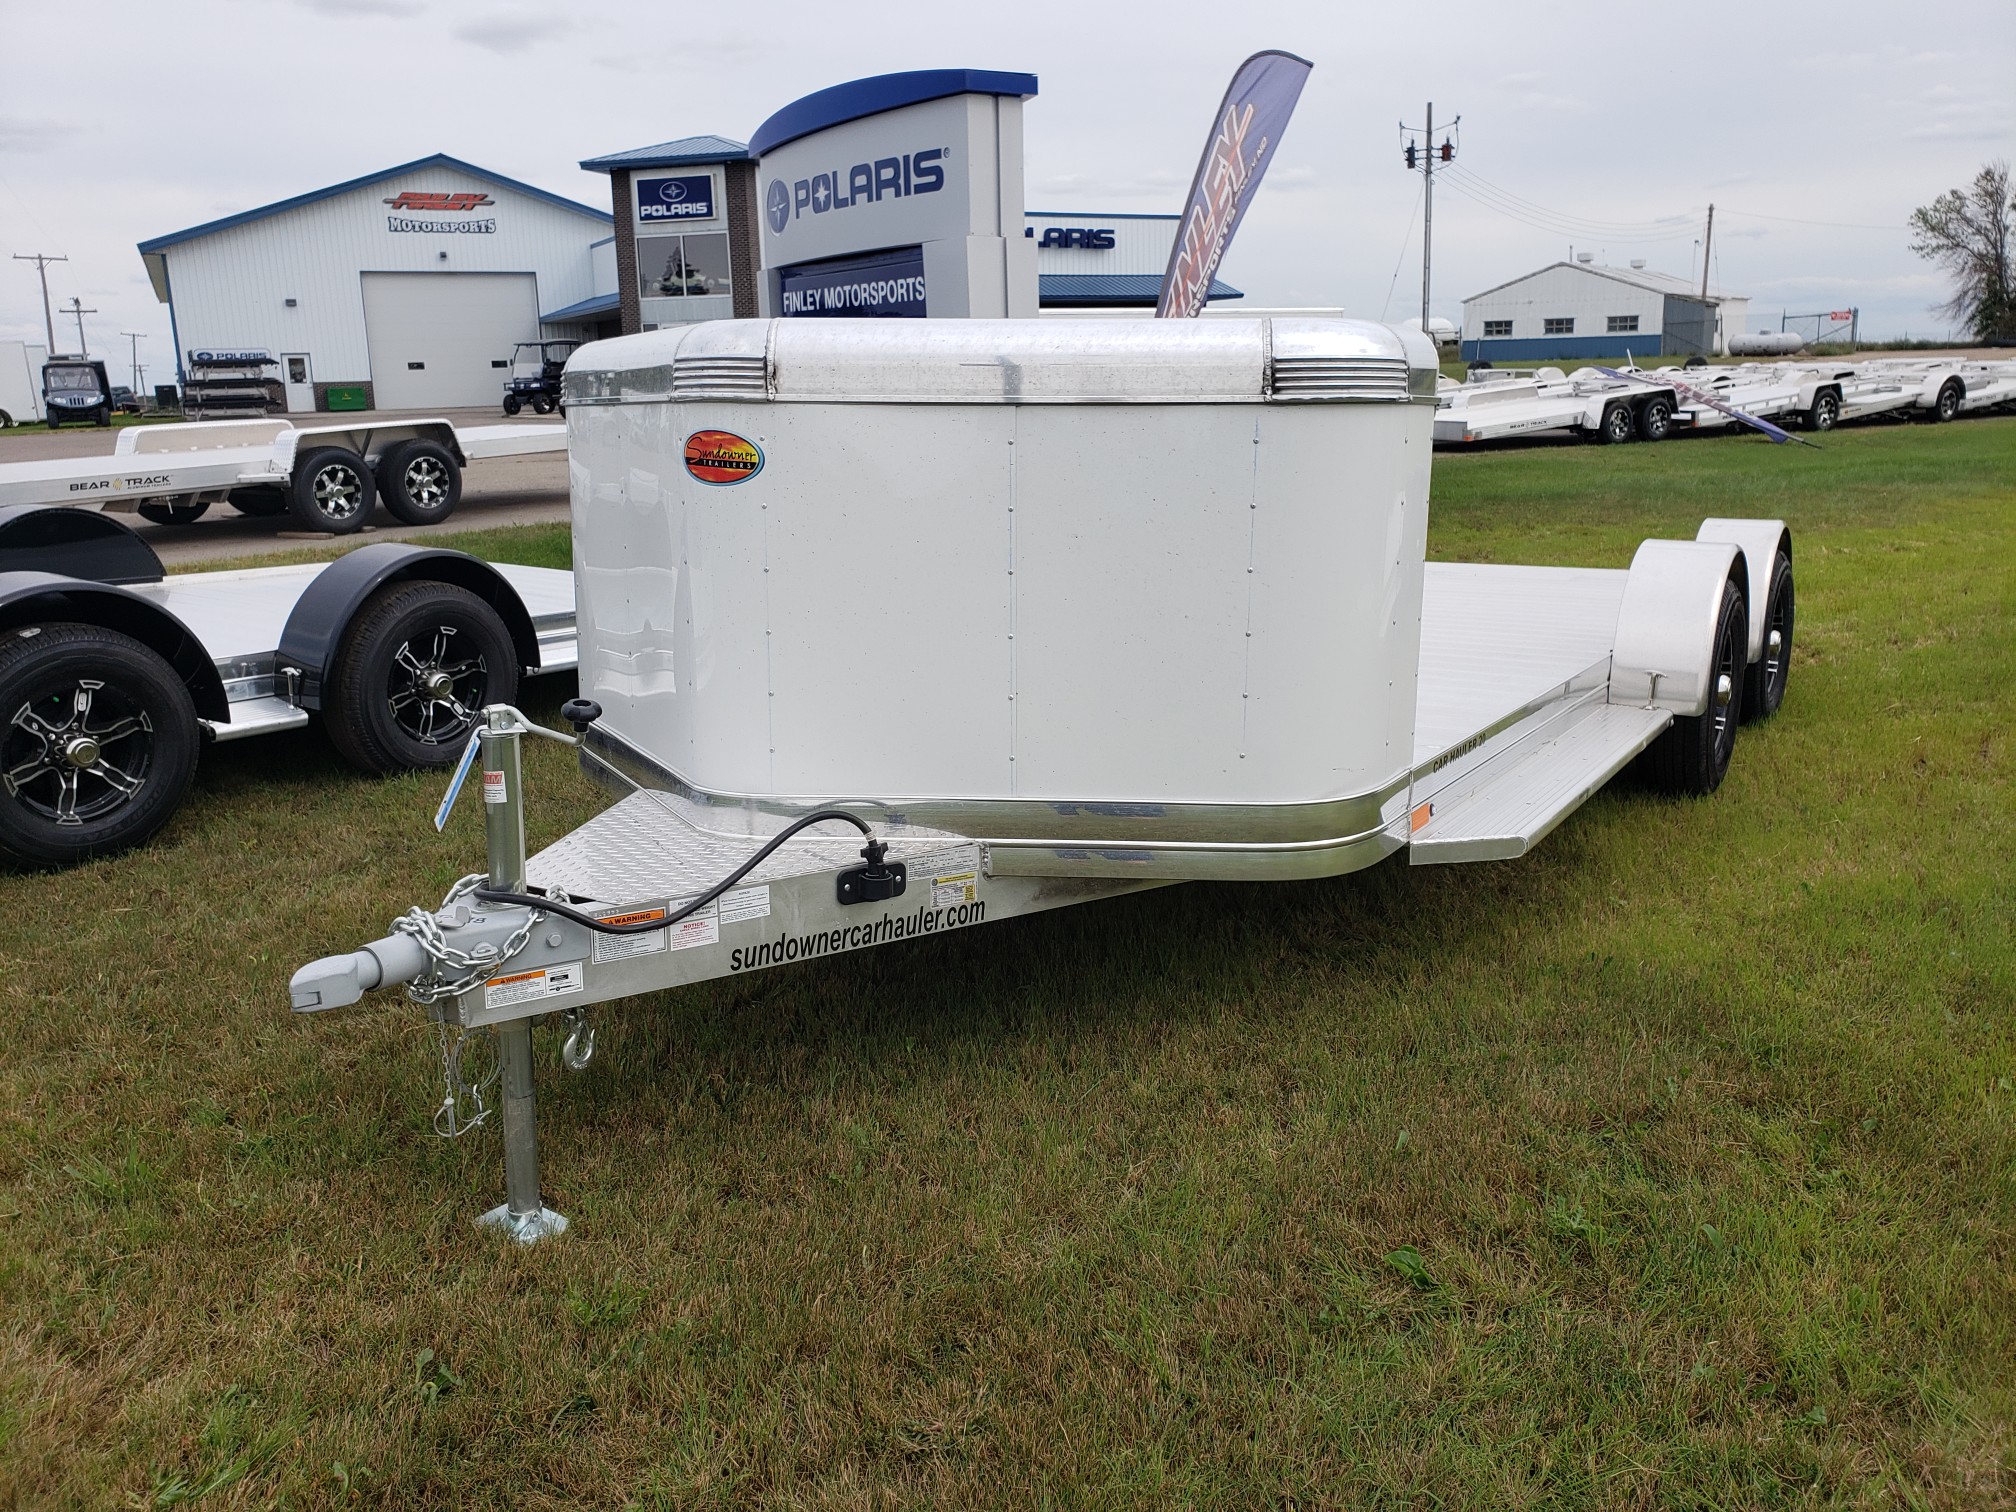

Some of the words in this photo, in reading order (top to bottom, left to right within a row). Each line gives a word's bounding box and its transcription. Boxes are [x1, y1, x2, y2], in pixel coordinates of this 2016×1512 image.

[794, 148, 944, 219] POLARIS
[641, 202, 708, 217] POLARIS
[388, 216, 496, 234] MOTORSPORTS
[1187, 206, 1237, 318] RSPORTS
[783, 288, 822, 313] FINLEY
[824, 276, 926, 309] MOTORSPORTS
[216, 352, 267, 360] POLARIS
[687, 436, 757, 463] Sundowner
[703, 459, 751, 469] TRAILERS
[69, 481, 110, 491] BEAR
[125, 475, 170, 486] TRACK
[1433, 755, 1449, 774] CAR
[1450, 738, 1477, 764] HAULER
[615, 913, 651, 924] WARNING
[730, 900, 986, 971] sundownercarhauler.com
[505, 973, 532, 983] WARNING
